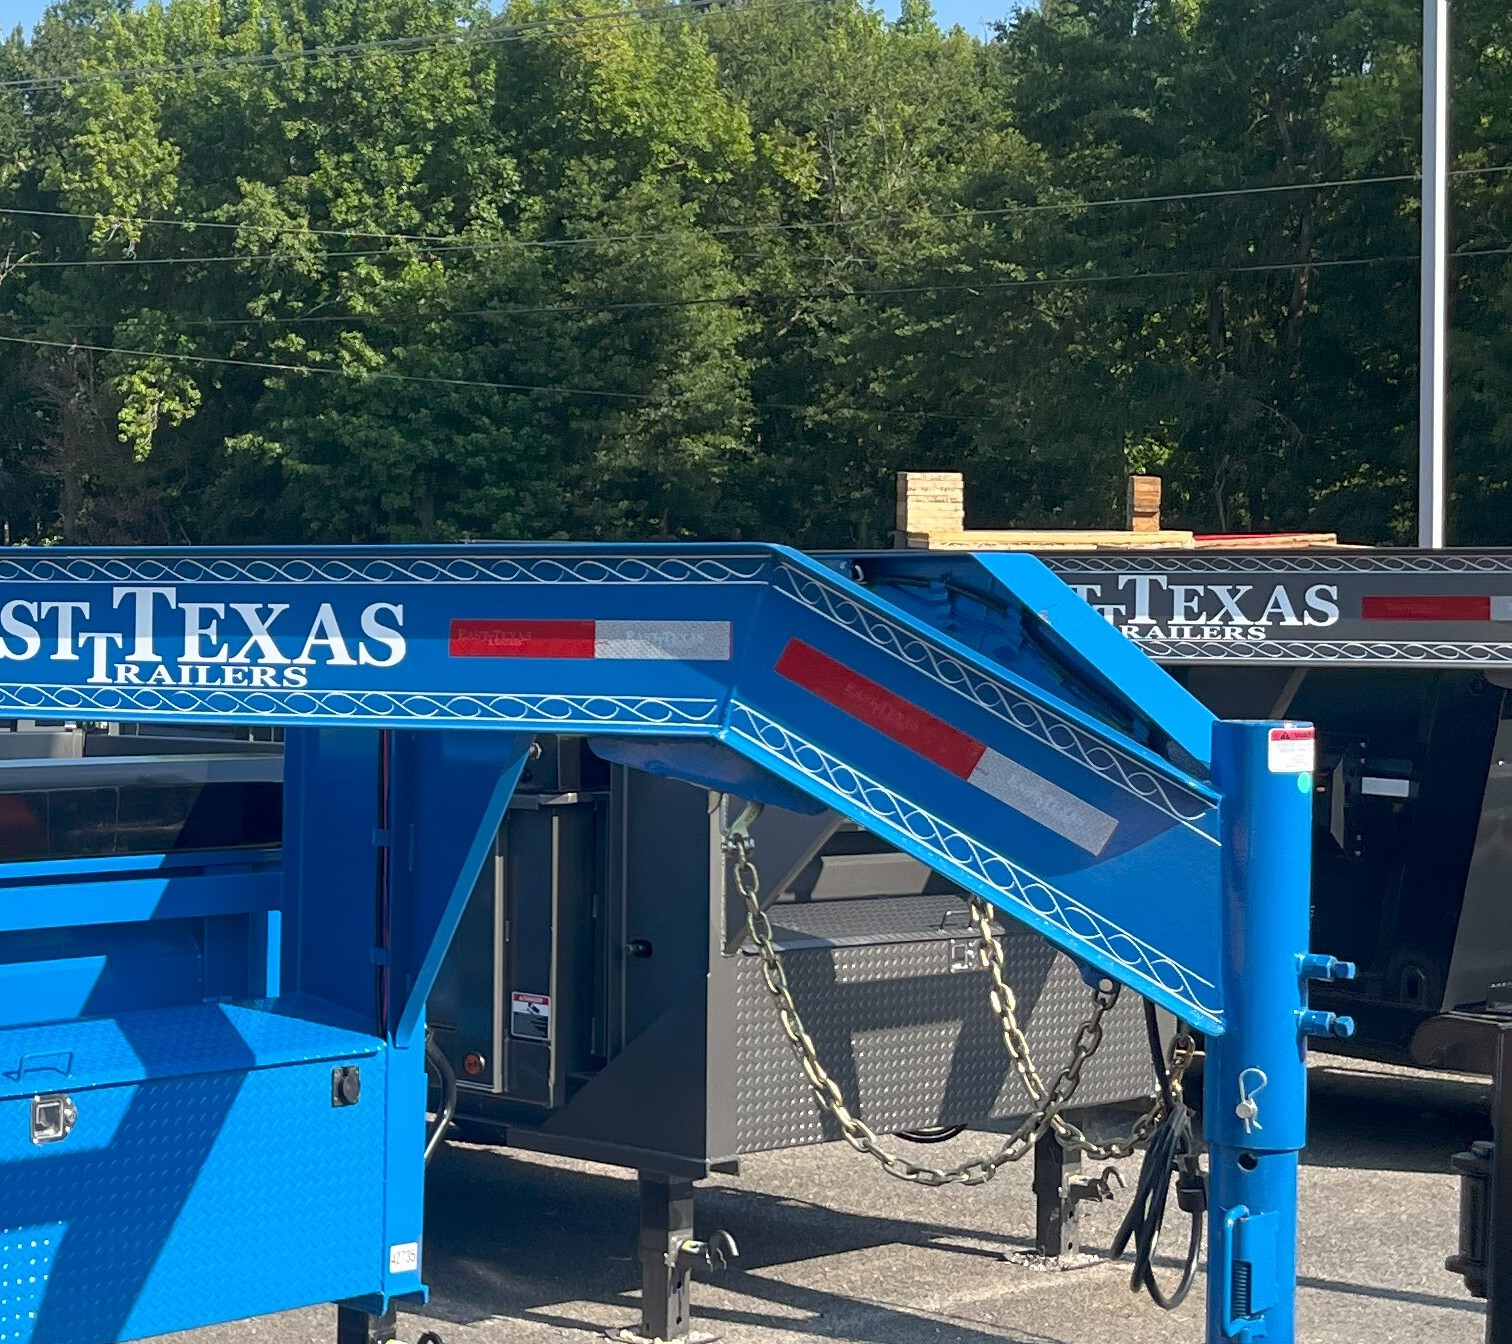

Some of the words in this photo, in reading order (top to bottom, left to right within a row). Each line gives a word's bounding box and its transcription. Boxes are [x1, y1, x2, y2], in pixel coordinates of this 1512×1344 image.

[112, 586, 407, 668] TEXAS
[1118, 574, 1339, 628] TEXAS
[78, 631, 308, 687] TRAILERS
[458, 629, 488, 641] EAST
[491, 628, 532, 641] TEXAS
